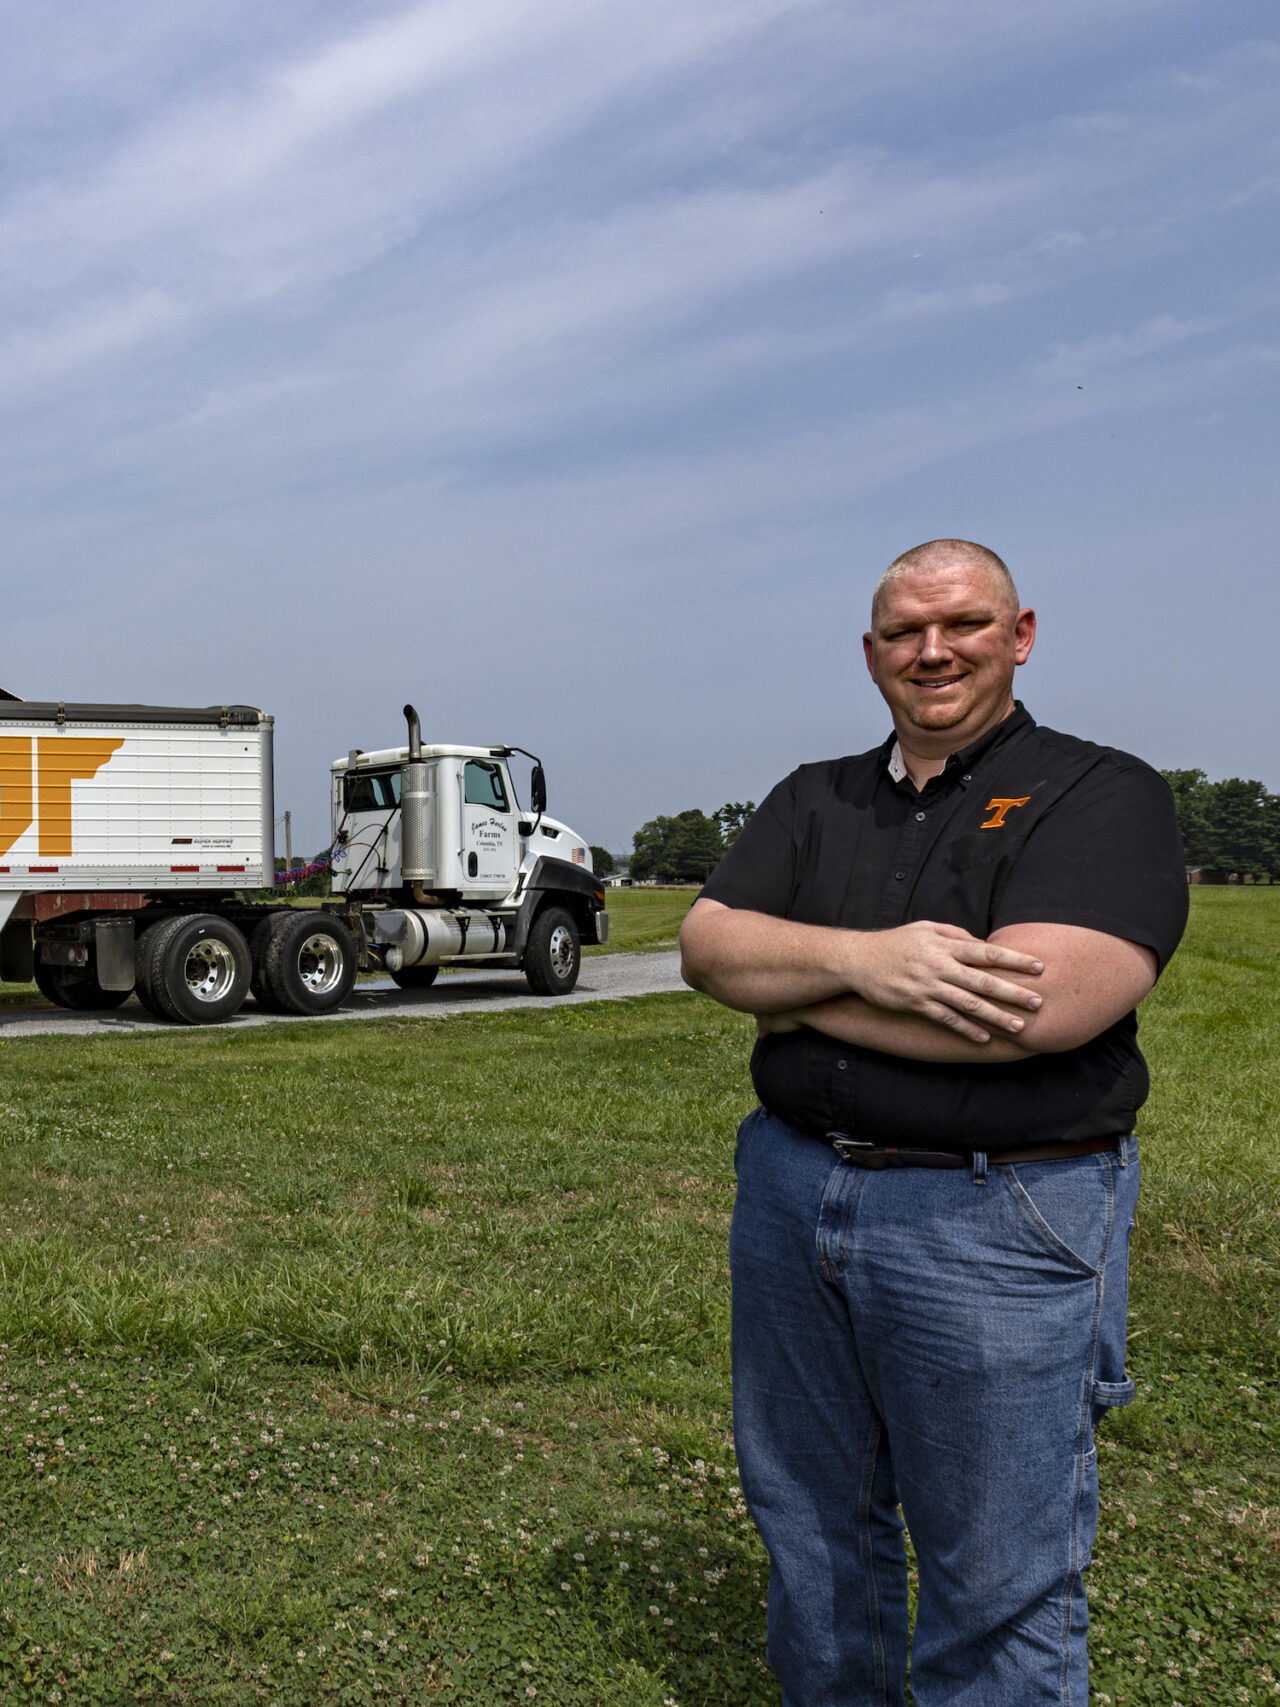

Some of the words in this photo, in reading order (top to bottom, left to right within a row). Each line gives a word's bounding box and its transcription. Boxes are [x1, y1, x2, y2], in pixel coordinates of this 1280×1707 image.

[979, 796, 1031, 829] T
[471, 821, 488, 834] James
[479, 830, 501, 838] Farms
